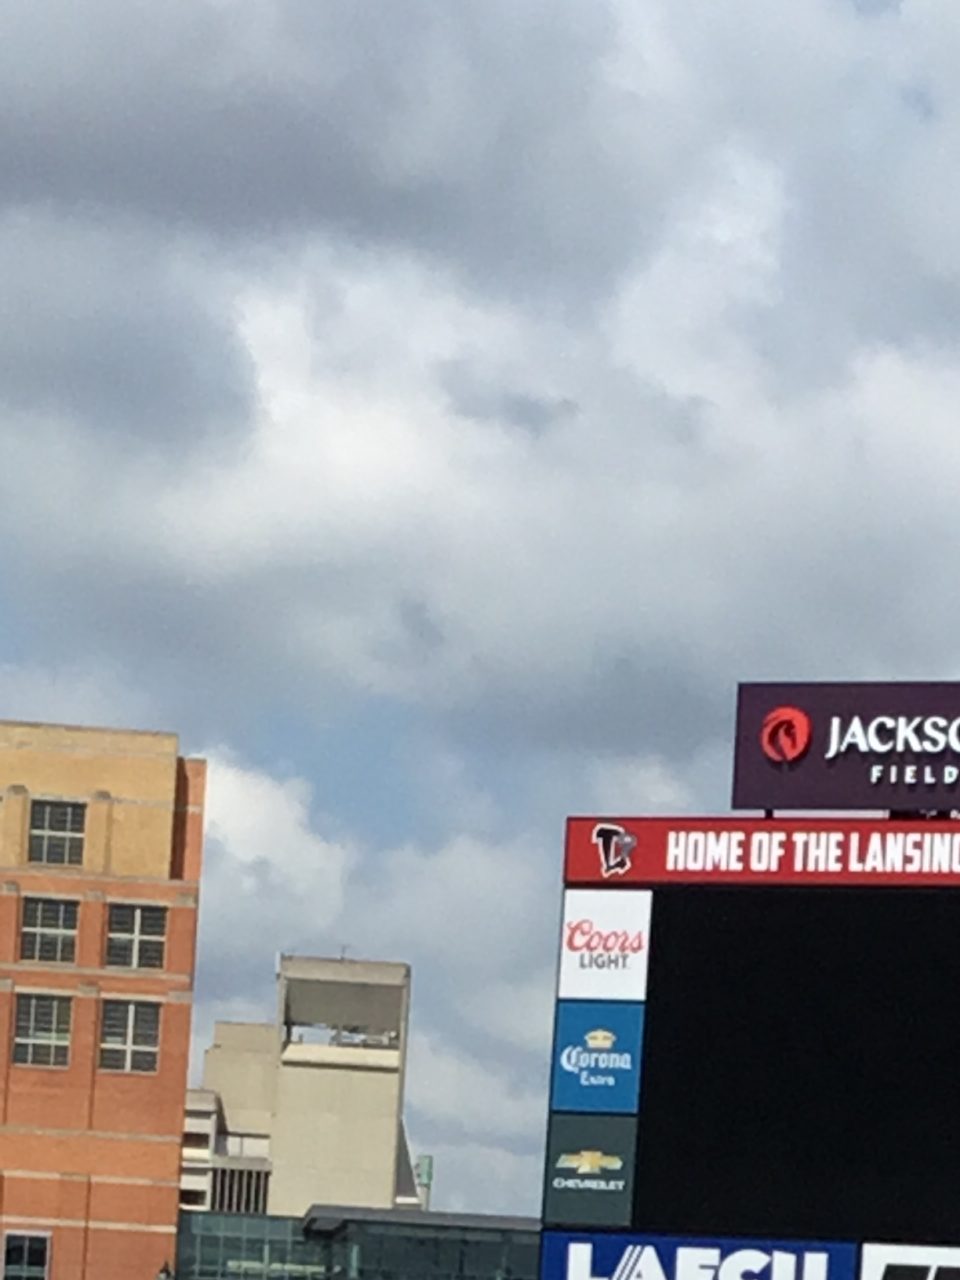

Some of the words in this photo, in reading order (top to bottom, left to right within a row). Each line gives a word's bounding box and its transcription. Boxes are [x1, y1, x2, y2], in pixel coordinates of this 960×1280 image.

[870, 765, 959, 784] FIELD
[666, 831, 745, 871] HOME
[750, 831, 787, 871] OF
[792, 832, 844, 872] THE
[566, 918, 644, 954] Coors
[579, 952, 630, 970] LIGHT
[560, 1045, 632, 1074] Corona
[552, 1177, 625, 1191] CHEVROLET
